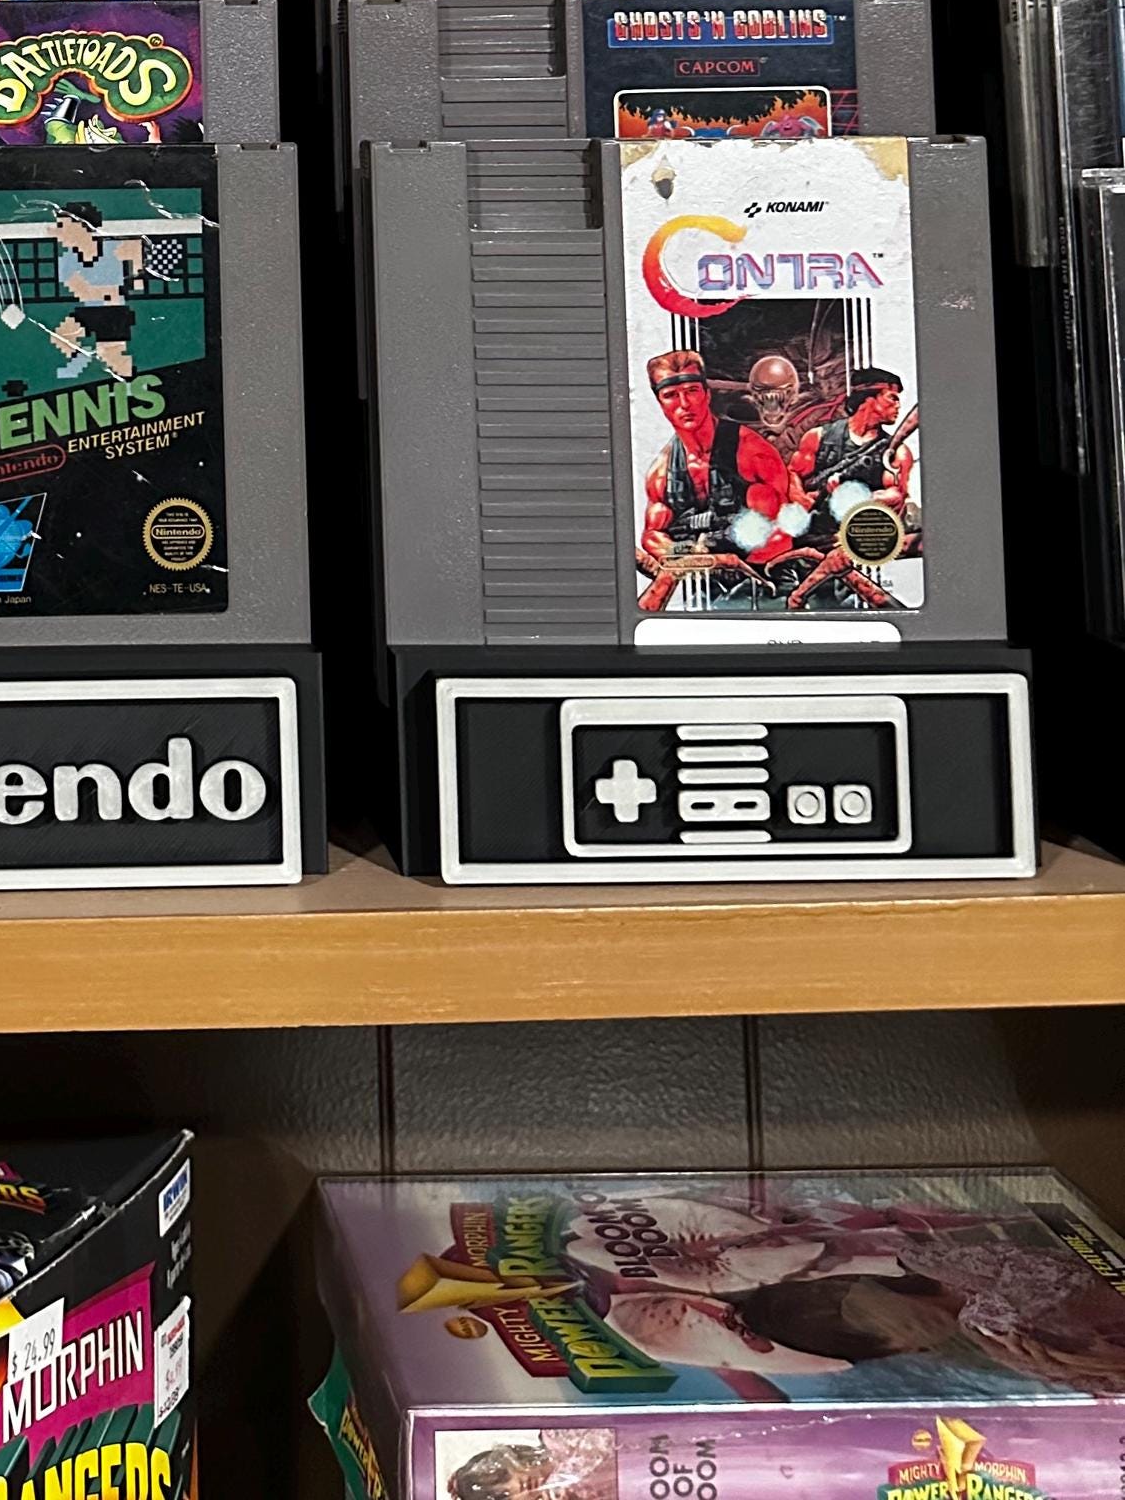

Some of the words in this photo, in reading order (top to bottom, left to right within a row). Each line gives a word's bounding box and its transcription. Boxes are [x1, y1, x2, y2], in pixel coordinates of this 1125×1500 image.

[734, 9, 828, 39] GOBLINS
[678, 60, 755, 74] CAPCOM
[765, 201, 825, 213] KONAMI
[642, 214, 885, 318] CONTRA
[68, 411, 206, 453] ENTERTAINMENT
[105, 434, 171, 460] SYSTEM
[155, 527, 201, 536] Nintendo
[4, 595, 32, 605] Japan
[582, 1210, 658, 1278] BLOOM
[607, 1199, 680, 1257] DOOM
[493, 1306, 560, 1363] MIGHTY
[530, 1297, 665, 1378] POWER
[2, 1310, 144, 1444] MORPHIN
[672, 1463, 694, 1498] OF
[898, 1462, 941, 1484] MIGHTY
[974, 1462, 1026, 1482] MORPHIN
